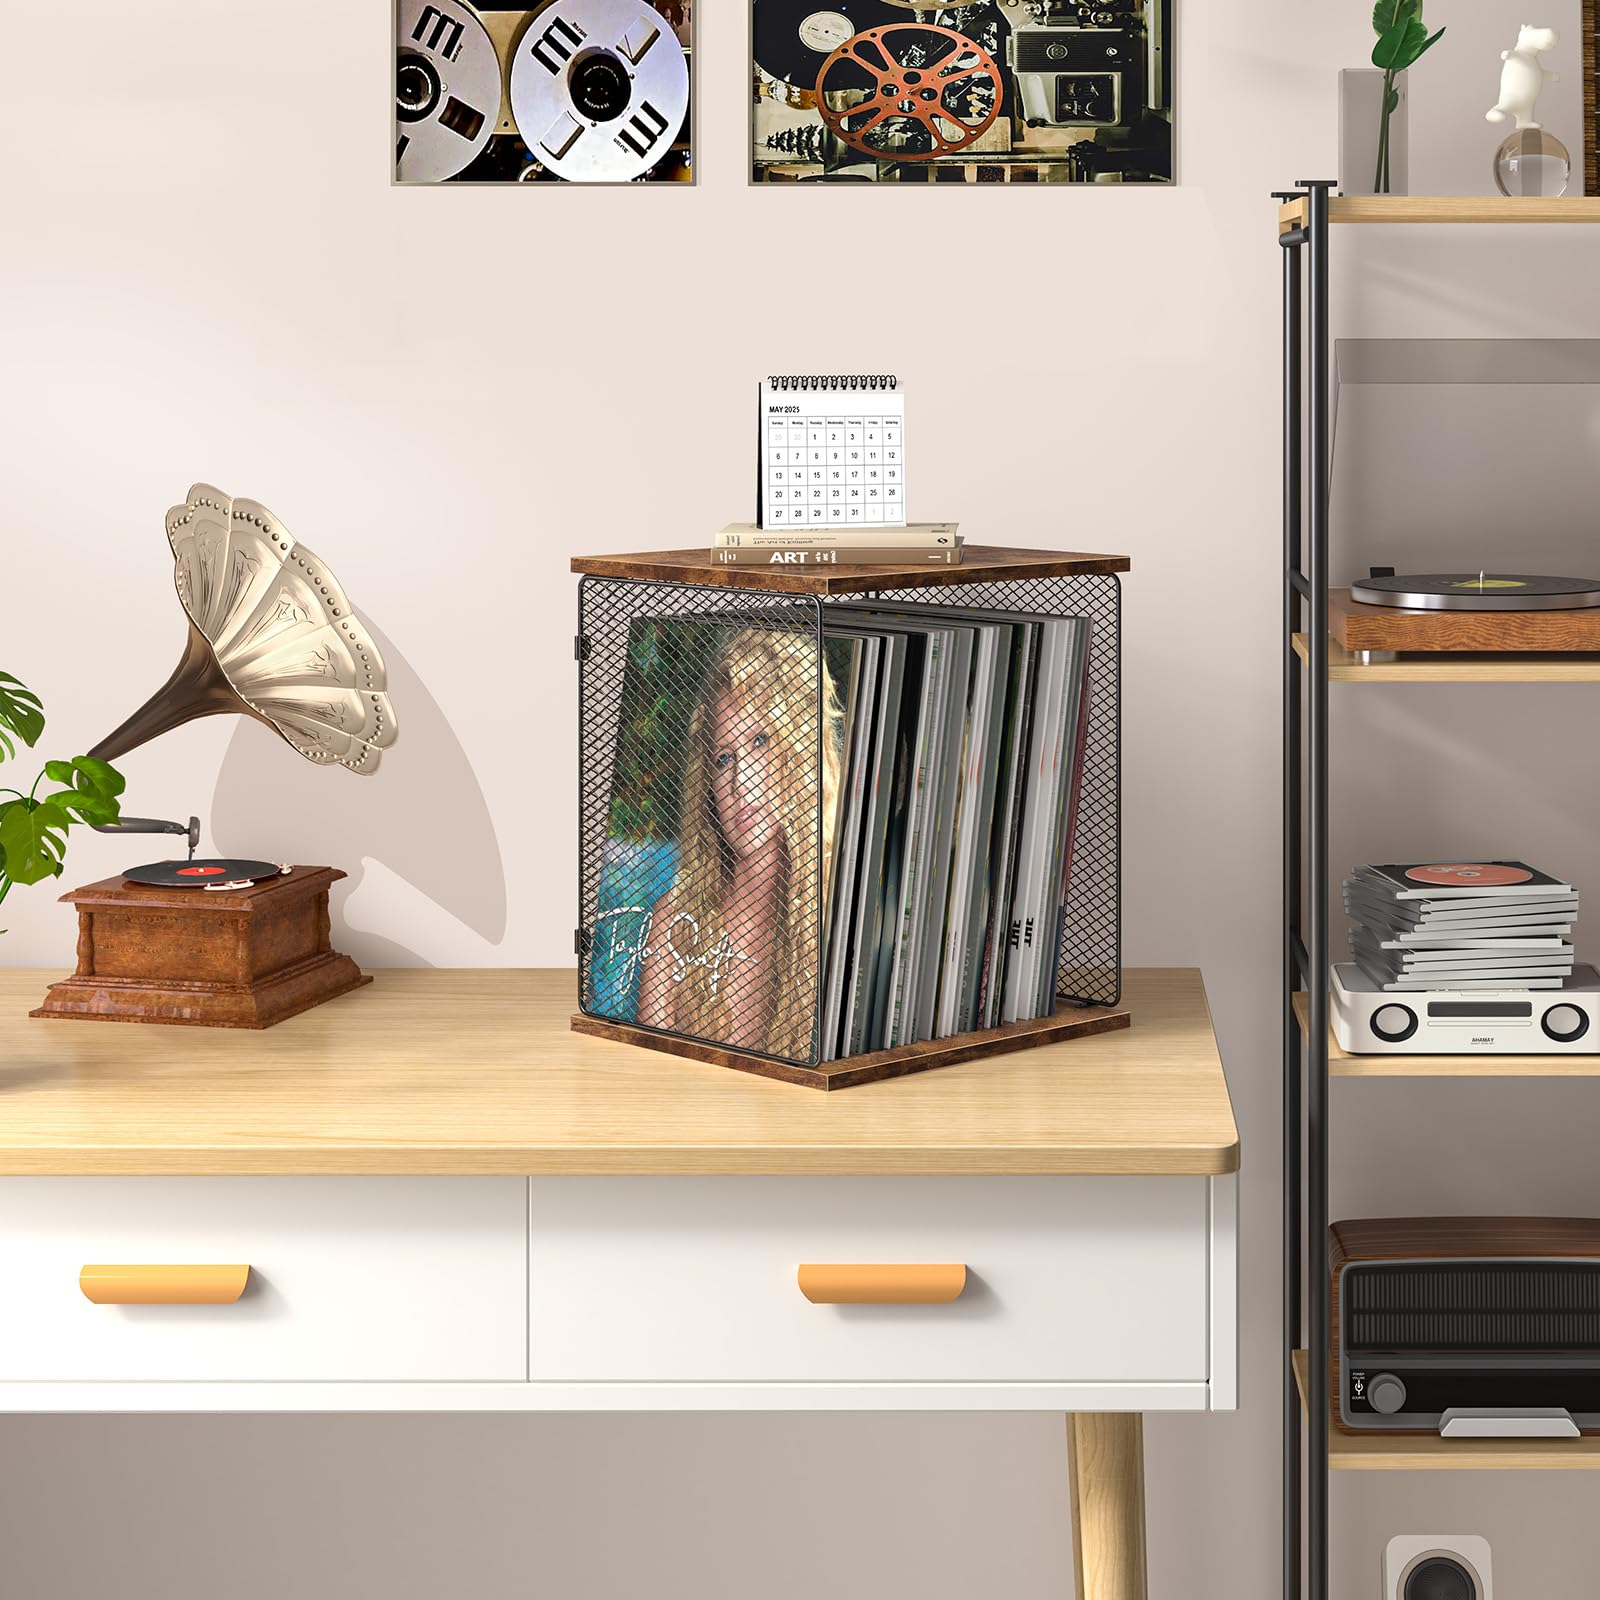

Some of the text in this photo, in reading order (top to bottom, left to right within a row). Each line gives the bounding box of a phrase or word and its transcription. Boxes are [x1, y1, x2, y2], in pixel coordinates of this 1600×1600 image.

[768, 405, 800, 414] MAY 2025
[851, 451, 859, 460] 10
[869, 451, 877, 459] 11
[888, 451, 896, 459] 12
[775, 472, 783, 480] 13
[813, 471, 821, 479] 15
[832, 471, 840, 479] 16
[851, 470, 859, 478] 17
[870, 470, 878, 478] 18
[888, 470, 896, 478] 19
[775, 488, 896, 499] 20 21 22 23 24 25 26
[775, 510, 783, 518] 27
[794, 509, 803, 518] 28
[813, 509, 822, 517] 29
[832, 508, 841, 517] 30
[851, 508, 859, 516] 31
[769, 551, 809, 564] ART
